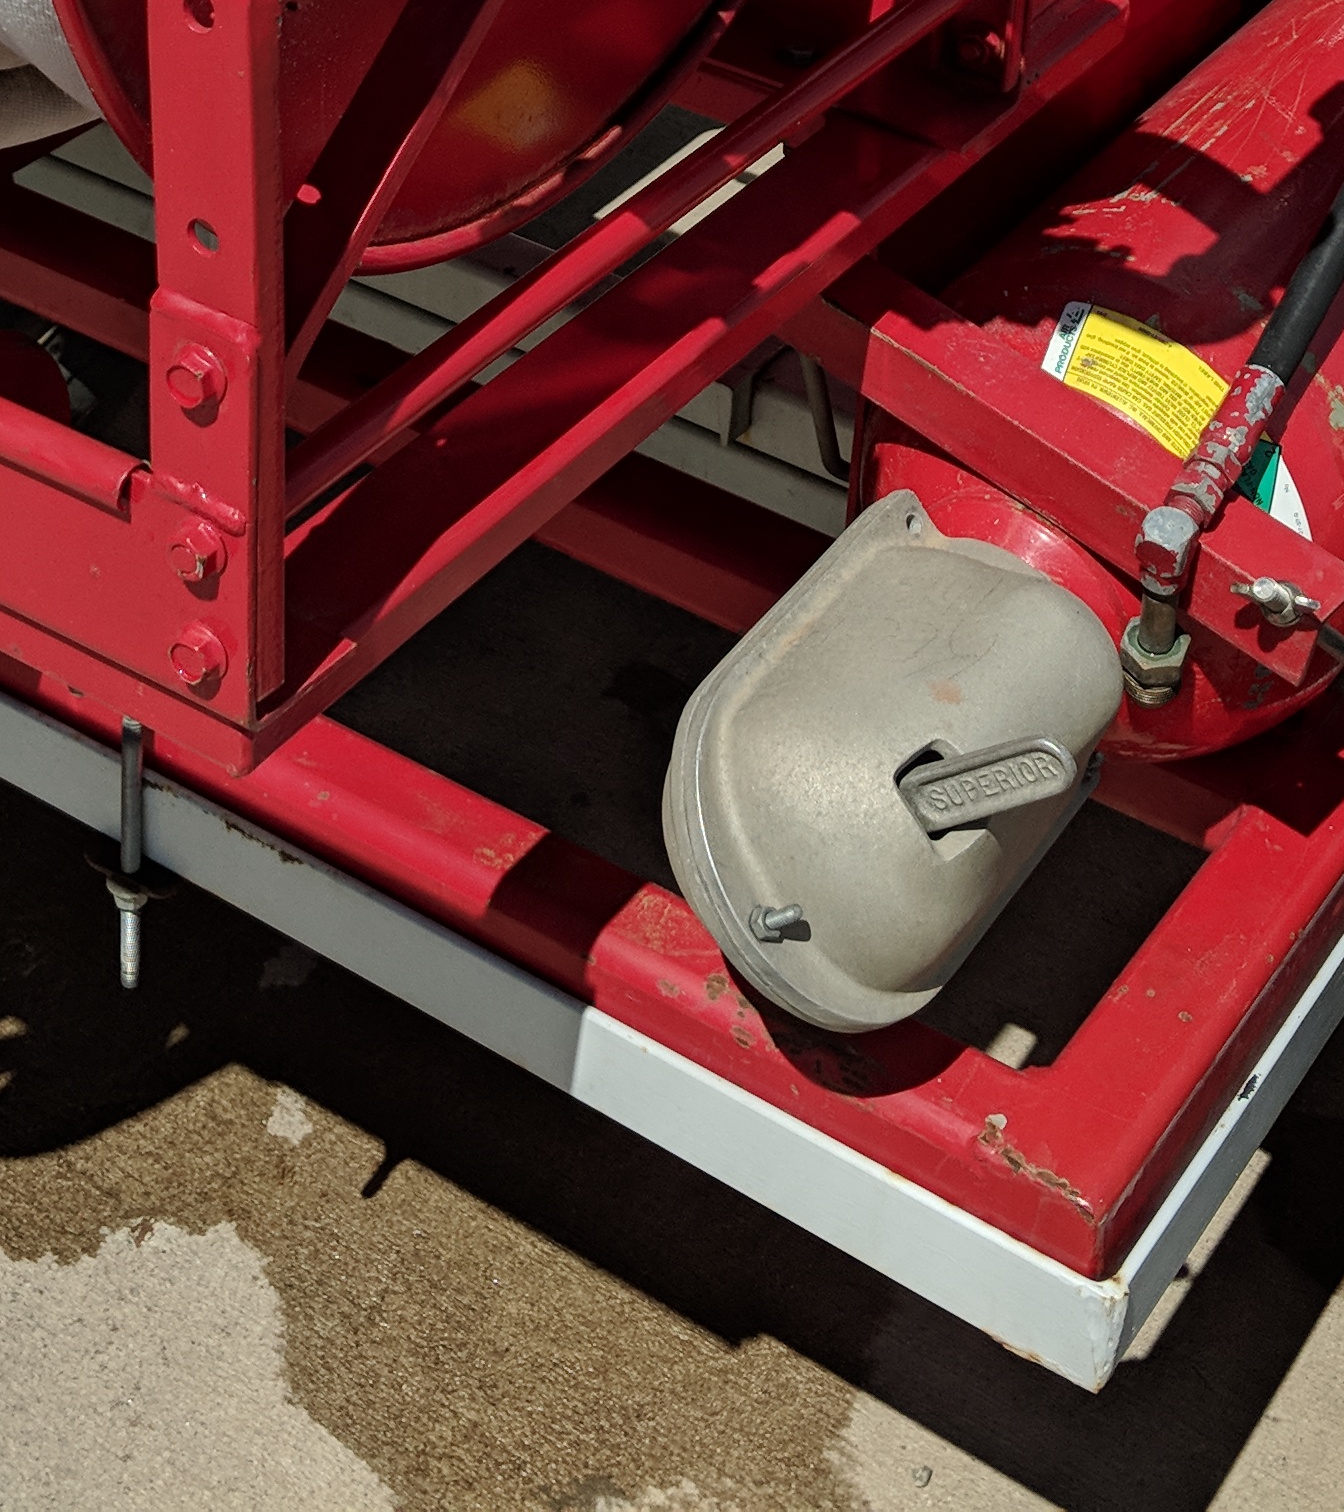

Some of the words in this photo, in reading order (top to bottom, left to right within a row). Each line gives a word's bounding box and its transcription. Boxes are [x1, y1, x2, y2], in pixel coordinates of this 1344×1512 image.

[1054, 325, 1080, 375] PRODUCTS
[1060, 323, 1073, 341] AIR
[928, 755, 1058, 812] SUPERIOR
